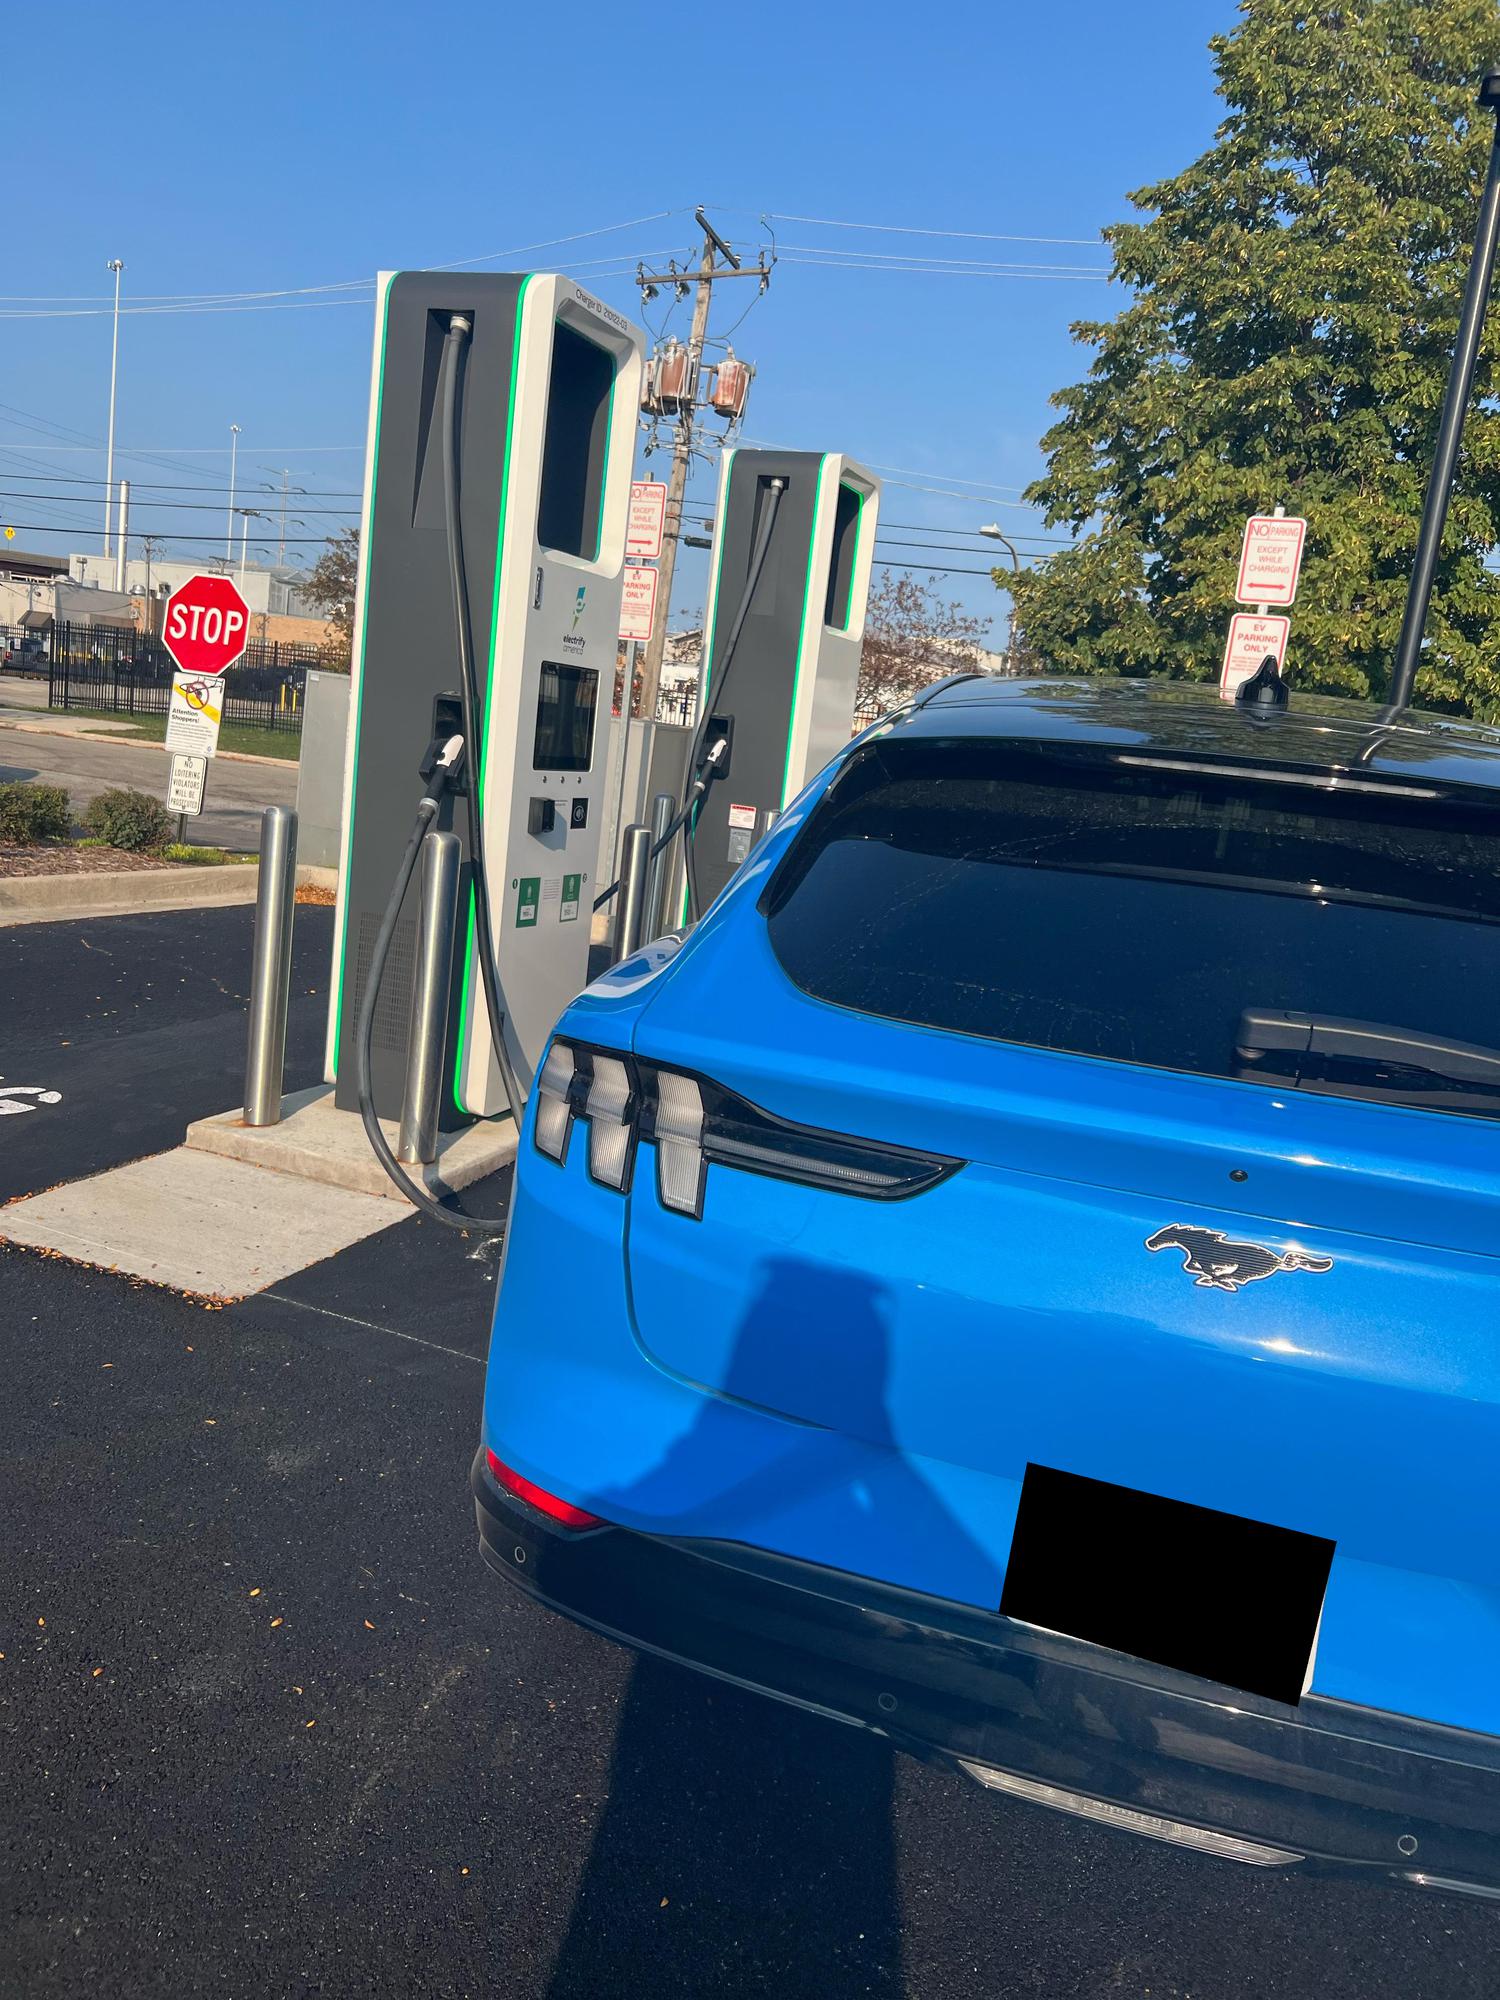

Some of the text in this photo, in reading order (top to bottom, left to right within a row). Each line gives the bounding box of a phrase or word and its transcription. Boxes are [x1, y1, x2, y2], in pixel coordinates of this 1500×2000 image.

[1250, 524, 1299, 537] NO PARKING
[1257, 545, 1288, 554] EXCEPT
[1249, 564, 1290, 574] CHARGING
[626, 591, 645, 599] ONLY
[169, 603, 244, 646] STOP
[1254, 624, 1266, 632] EV
[563, 633, 586, 648] electrify
[1237, 633, 1278, 644] PARKING
[1243, 644, 1268, 653] ONLY
[171, 708, 199, 717] Attention
[184, 760, 193, 769] NO
[174, 769, 201, 780] LOITERING
[173, 779, 200, 790] VIOLATORS
[175, 789, 187, 798] WILL
